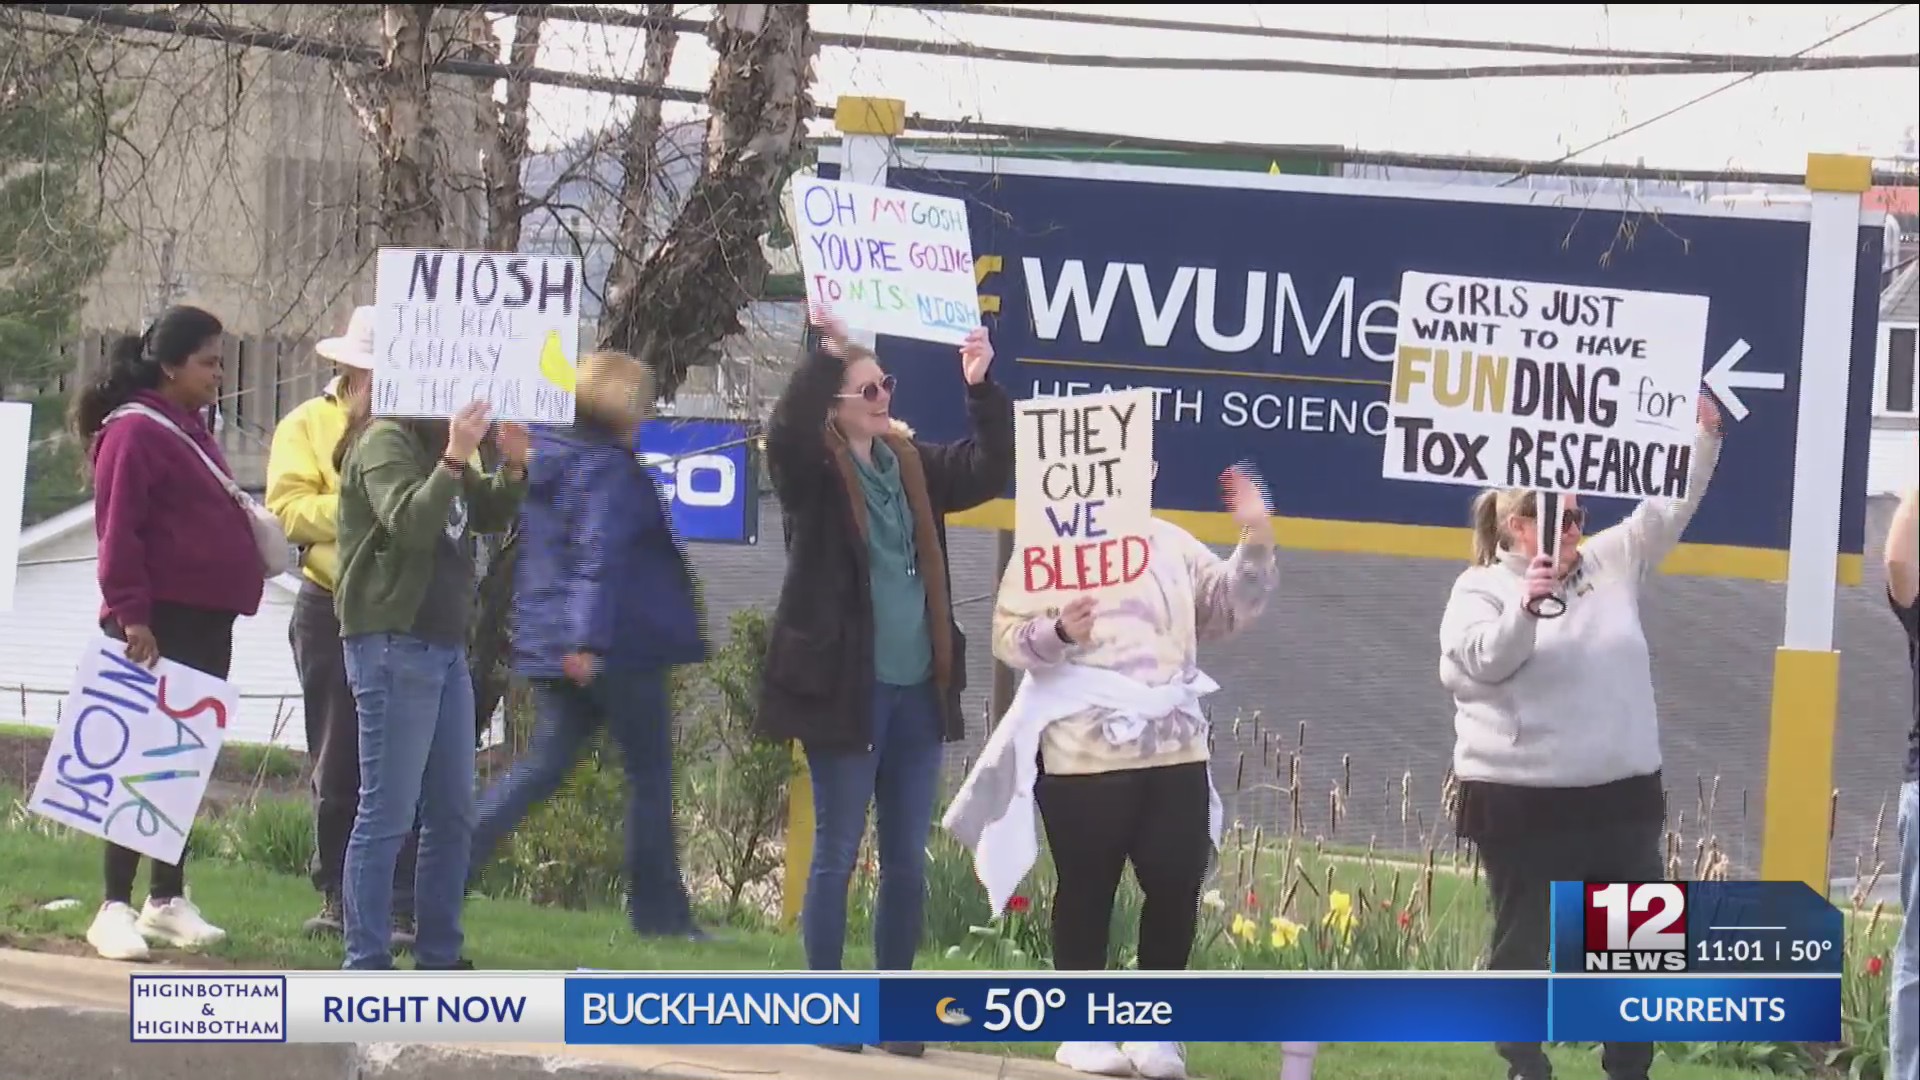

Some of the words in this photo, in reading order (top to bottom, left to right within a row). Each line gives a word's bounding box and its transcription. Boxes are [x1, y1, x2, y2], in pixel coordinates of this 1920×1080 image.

[804, 185, 856, 227] OH
[872, 197, 908, 224] MY
[911, 202, 963, 232] GOSH
[811, 231, 903, 273] YOU'RE
[909, 241, 973, 274] GOING
[408, 252, 575, 316] NIOSH
[814, 275, 843, 304] TO
[849, 278, 913, 311] MIS
[916, 293, 979, 327] NIOSH
[1425, 281, 1529, 319] GIRLS
[1541, 289, 1624, 328] JUST
[392, 302, 443, 337] THE
[1412, 317, 1501, 346] WANT
[1520, 328, 1560, 350] TO
[1576, 335, 1648, 359] HAVE
[376, 378, 400, 411] IN
[1032, 379, 1203, 425] HETH
[1394, 345, 1621, 429] FUNDING
[1628, 375, 1687, 421] for
[1022, 402, 1137, 460] THEY
[1506, 426, 1692, 499] RESEARCH
[1045, 499, 1108, 537] WE
[1023, 535, 1150, 593] BLEED
[42, 648, 158, 824] NIOSH
